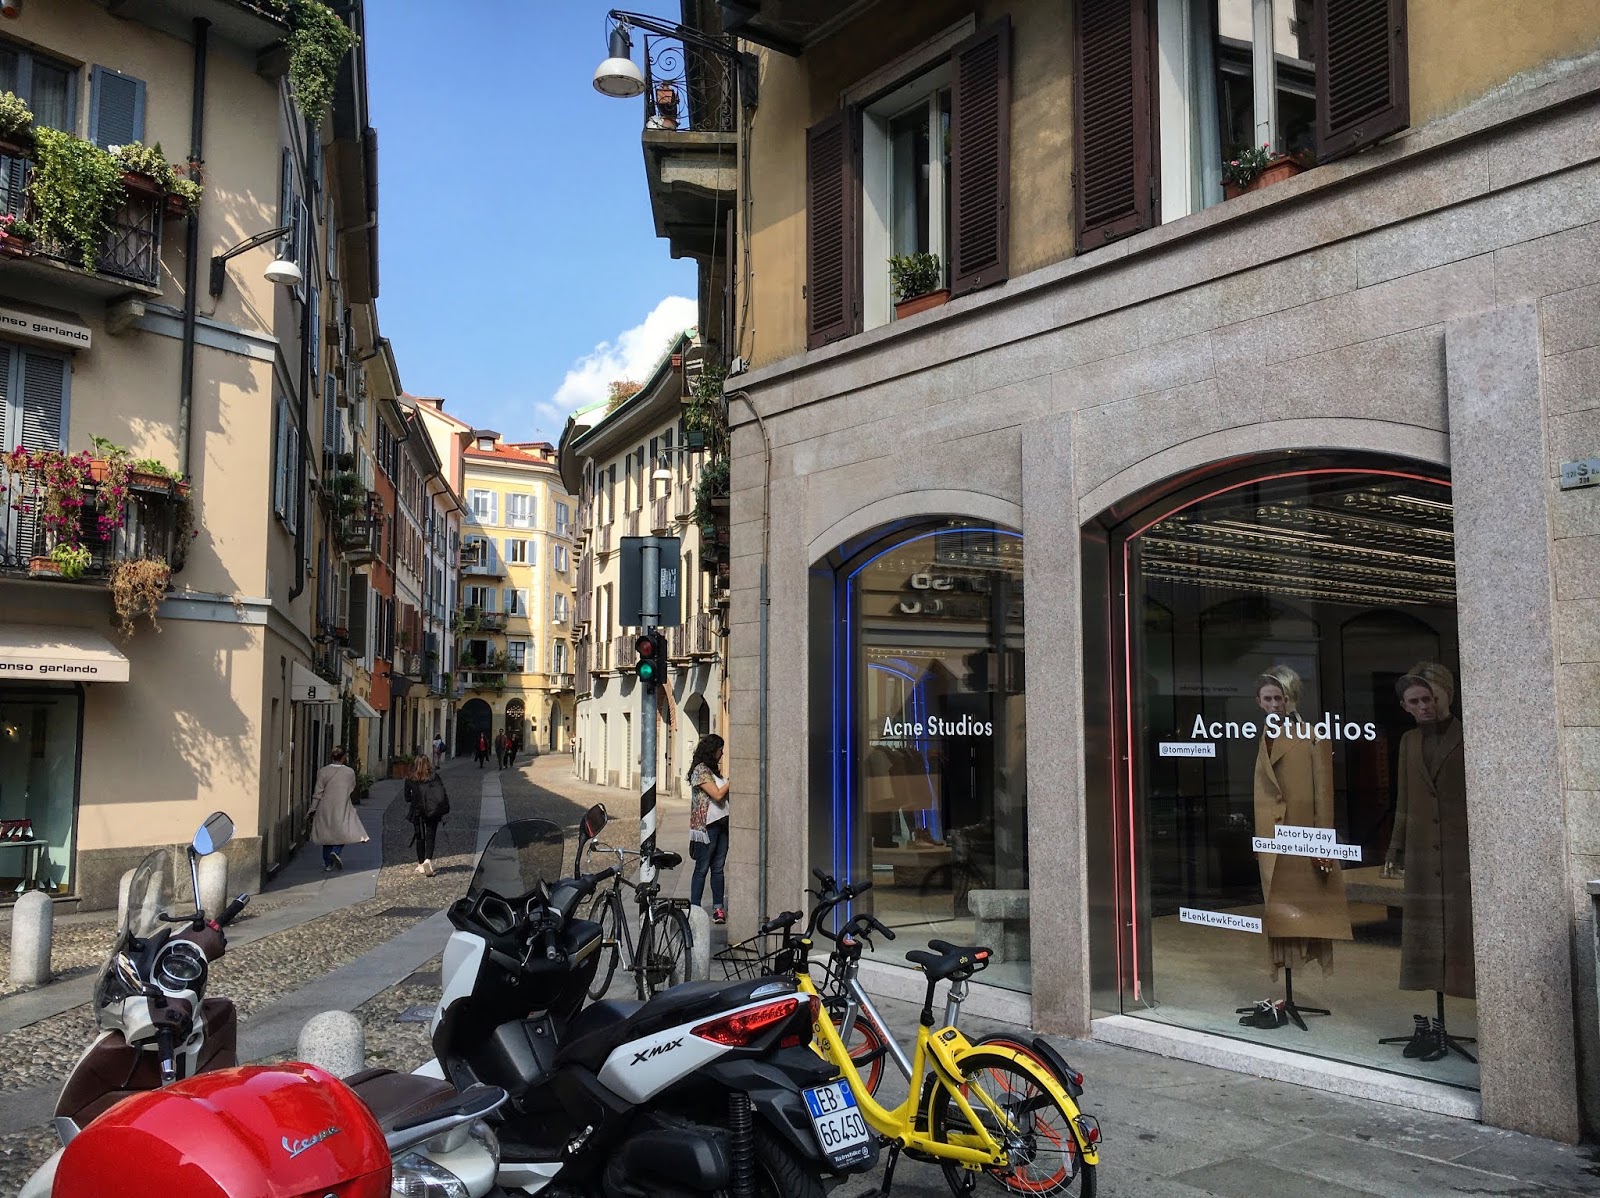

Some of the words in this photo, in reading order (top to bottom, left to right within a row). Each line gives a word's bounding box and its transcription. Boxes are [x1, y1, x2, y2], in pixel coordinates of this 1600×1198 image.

[0, 316, 27, 327] nso
[33, 323, 89, 341] garlando
[39, 664, 98, 673] garlando
[883, 717, 923, 736] Acne
[927, 714, 993, 736] Studios
[1191, 713, 1258, 739] Acne
[1265, 712, 1377, 741] Studios
[1161, 745, 1212, 755] @tommylenk
[1277, 828, 1301, 838] Actor
[1302, 829, 1314, 841] by
[1315, 830, 1332, 843] day
[1254, 839, 1293, 853] Garbage
[1294, 843, 1318, 853] tailor
[1319, 844, 1332, 857] by
[1333, 846, 1358, 858] night
[1181, 911, 1259, 930] #LenkLewkForLess
[816, 1087, 838, 1113] EB
[820, 1113, 866, 1147] 66450
